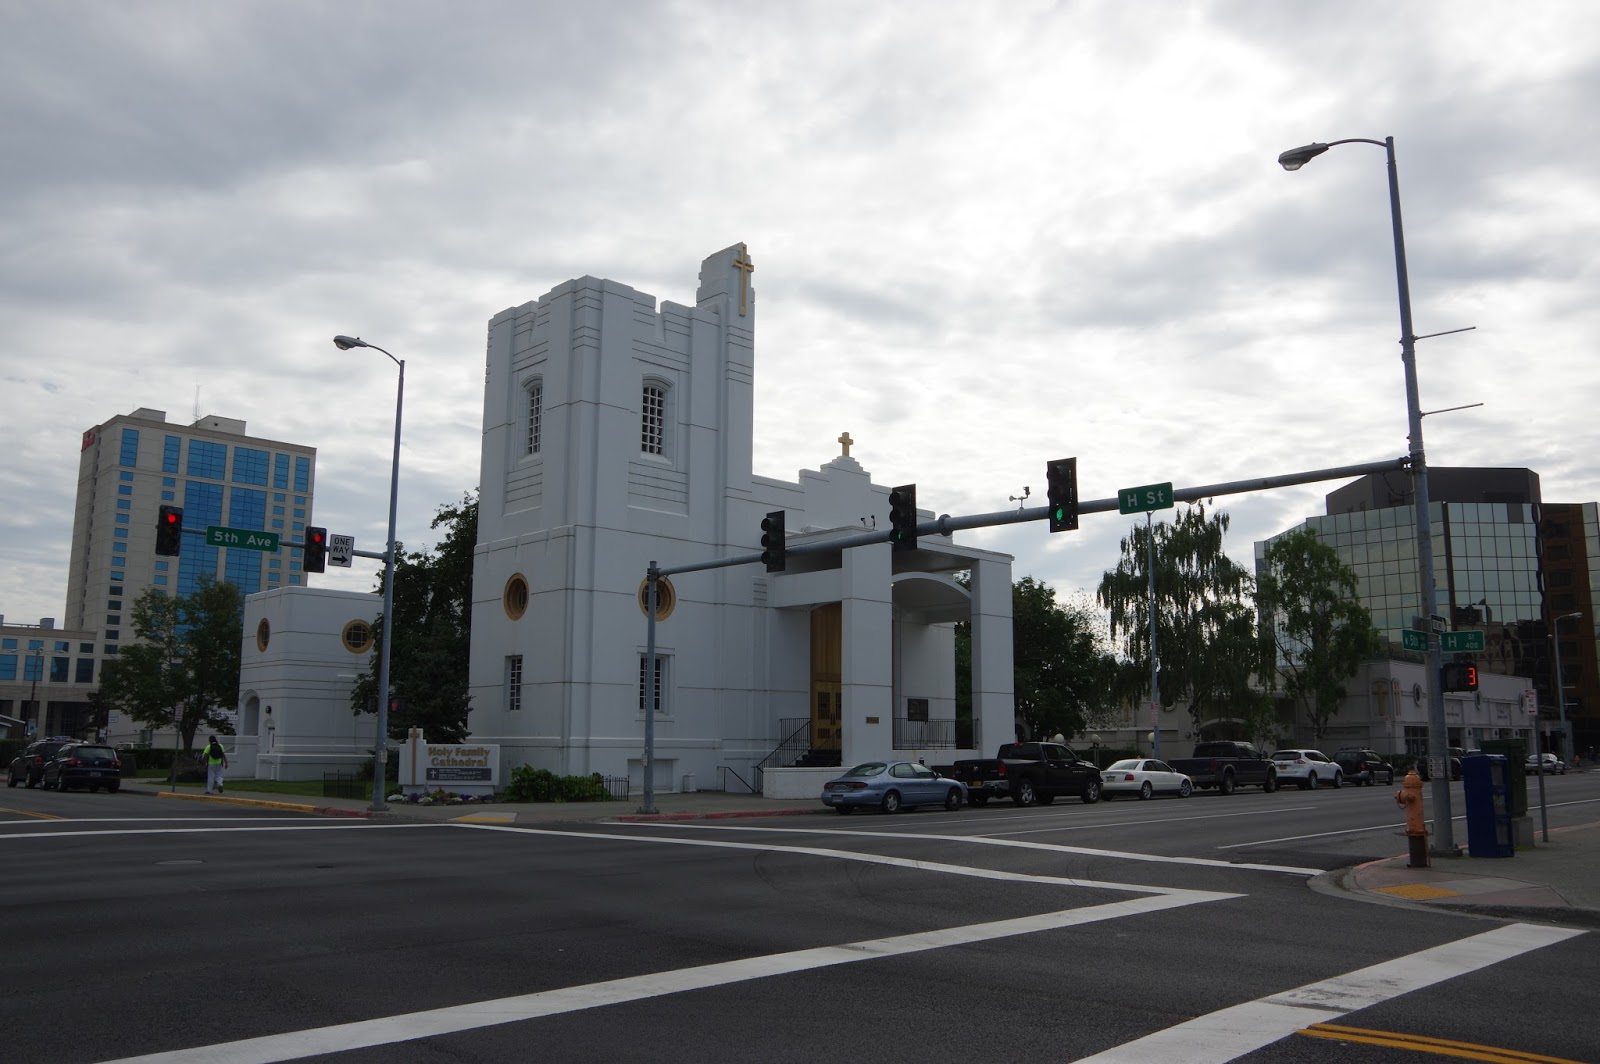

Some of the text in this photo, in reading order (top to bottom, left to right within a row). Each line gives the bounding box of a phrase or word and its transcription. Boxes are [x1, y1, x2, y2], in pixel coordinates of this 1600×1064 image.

[1127, 490, 1164, 507] H St
[214, 531, 271, 547] 5th Ave
[334, 537, 350, 546] ONE
[333, 546, 350, 554] WAY
[1448, 636, 1457, 648] H
[1468, 667, 1476, 685] 3
[428, 747, 490, 758] Holy Family
[431, 757, 488, 767] Cathedral
